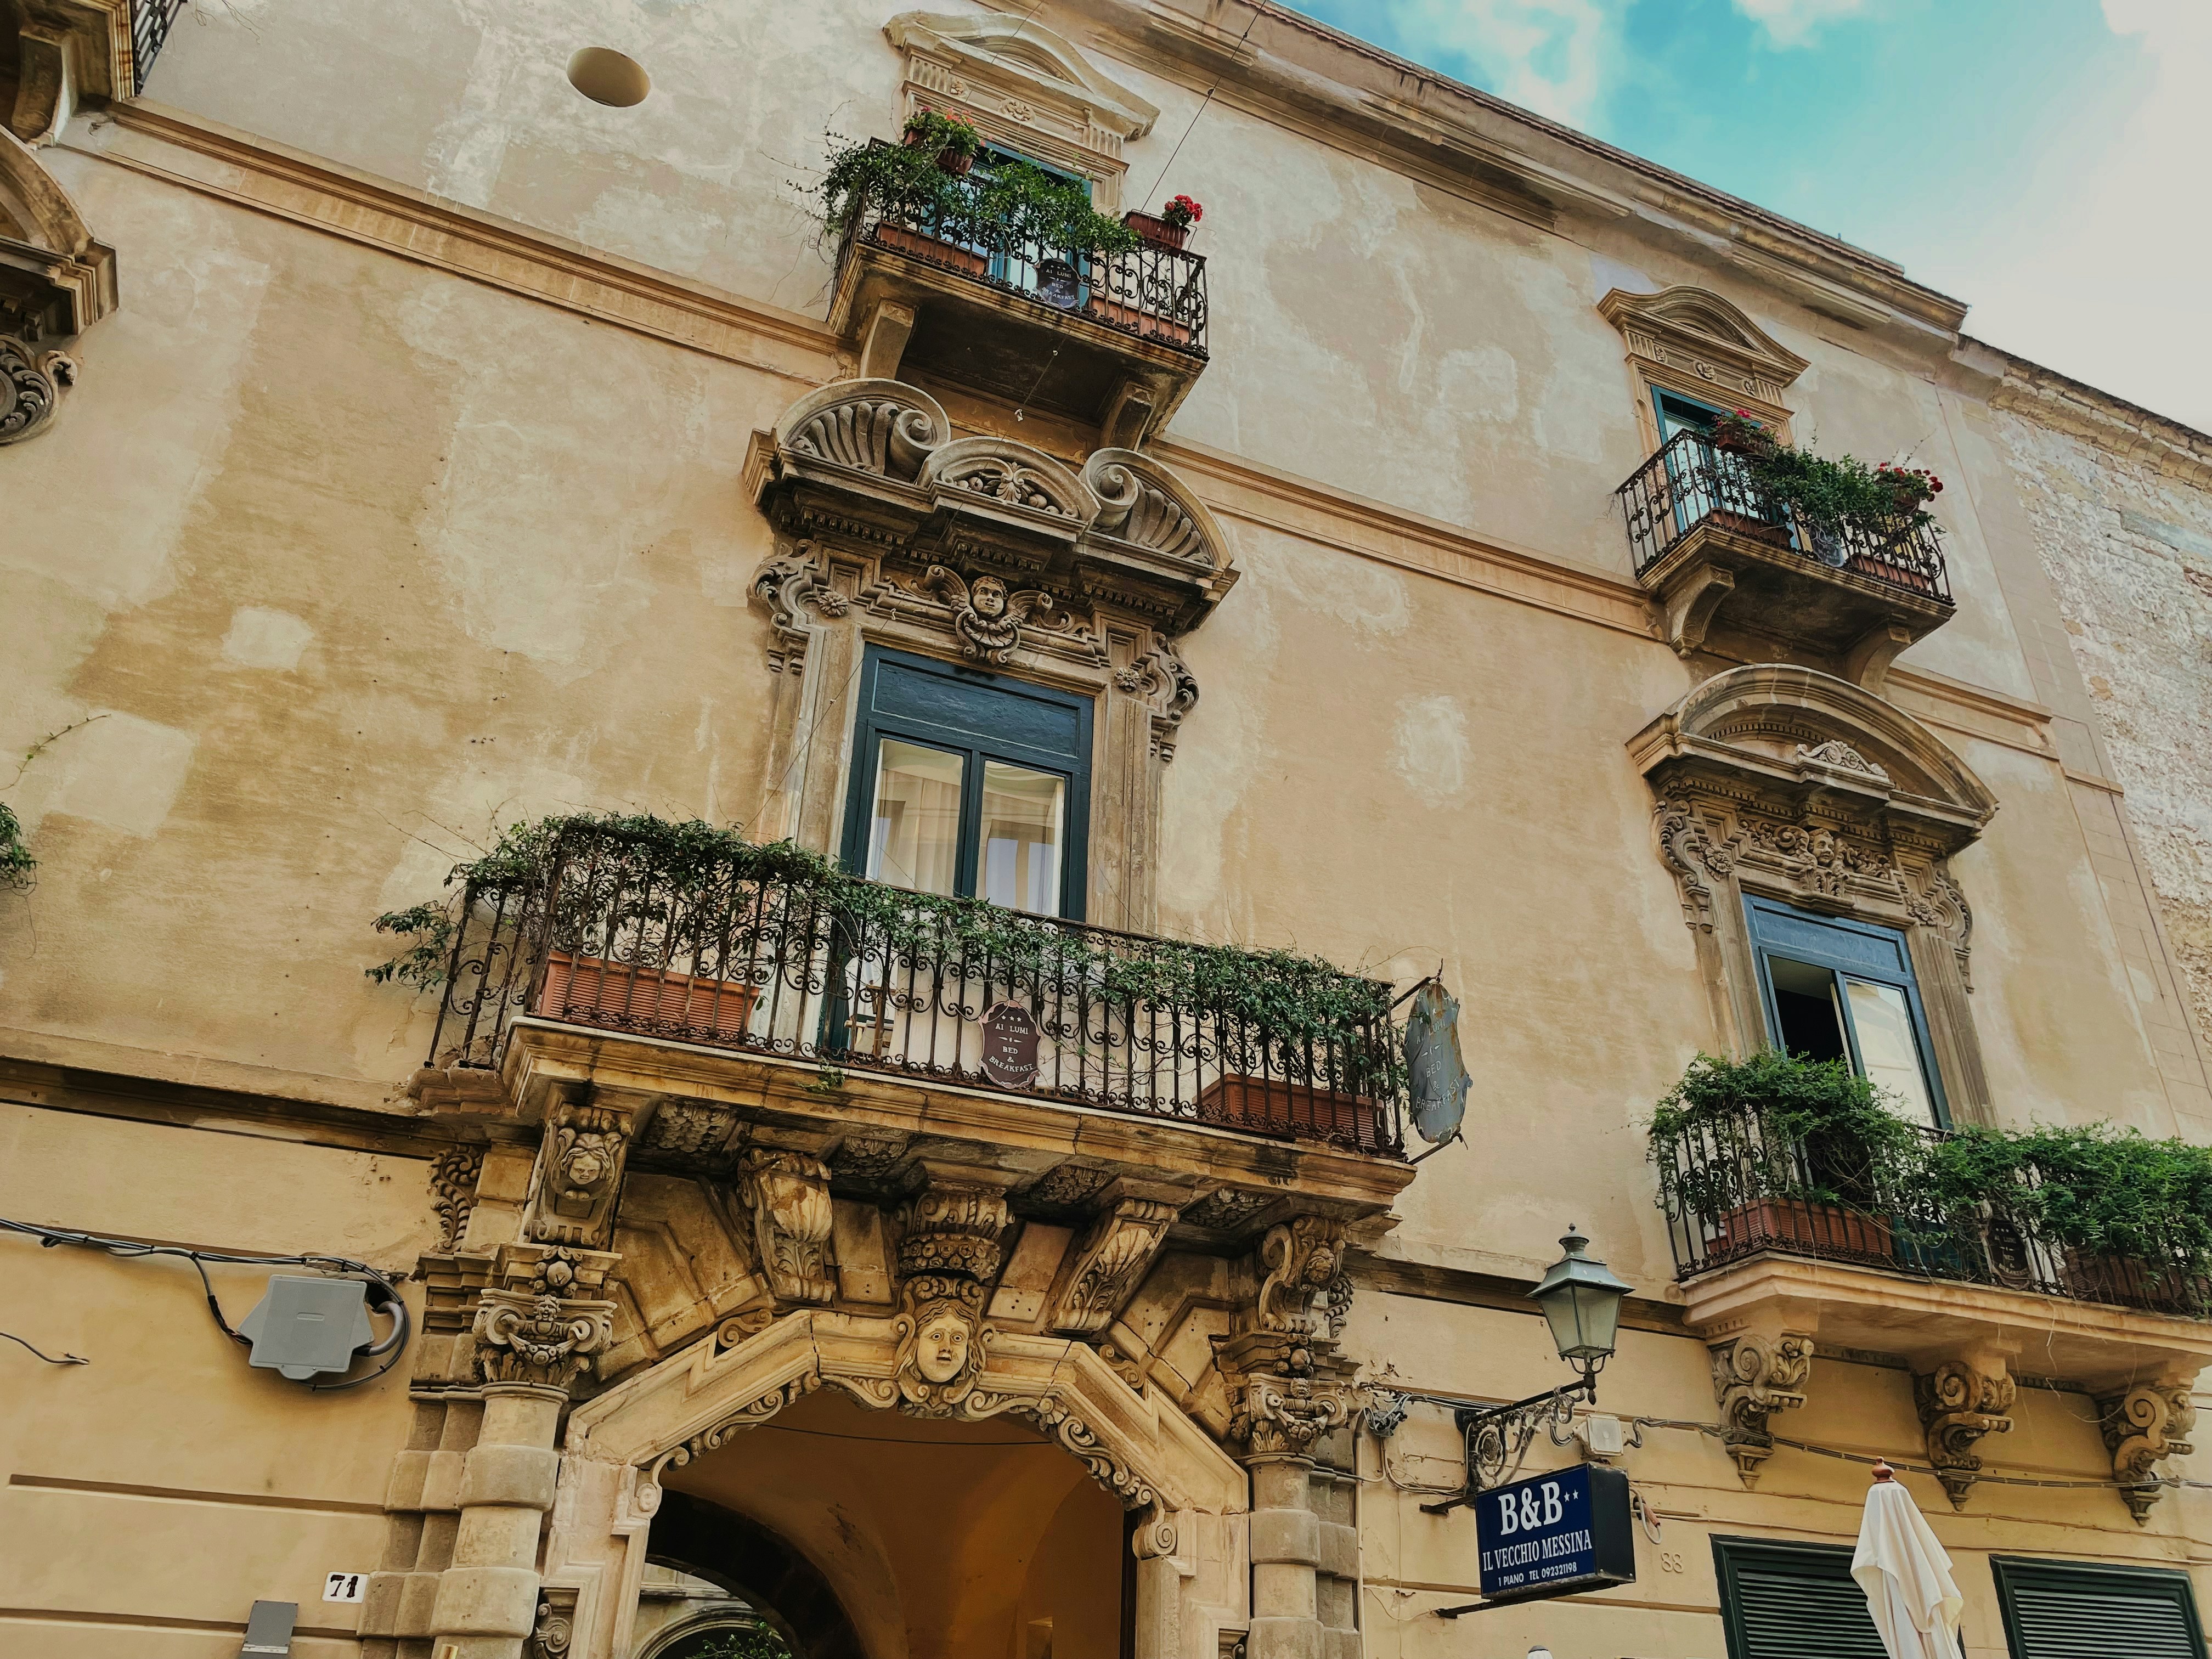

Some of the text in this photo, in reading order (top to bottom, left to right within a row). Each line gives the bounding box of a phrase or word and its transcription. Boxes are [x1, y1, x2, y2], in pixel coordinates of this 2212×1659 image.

[1009, 1025, 1029, 1035] LUMI
[1429, 1020, 1446, 1036] LUMI
[1002, 1046, 1018, 1054] BED
[989, 1056, 1034, 1073] BREAKFAST
[1426, 1060, 1441, 1077] BED
[1416, 1075, 1460, 1111] BREAKFAST
[1432, 1080, 1440, 1091] &
[1498, 1481, 1563, 1536] B&B
[1482, 1529, 1593, 1572] IL VECCHIO MESSINA
[1661, 1552, 1684, 1573] 88
[1498, 1561, 1577, 1587] 1 PIANO TEL 092321198
[330, 1575, 358, 1598] 71
